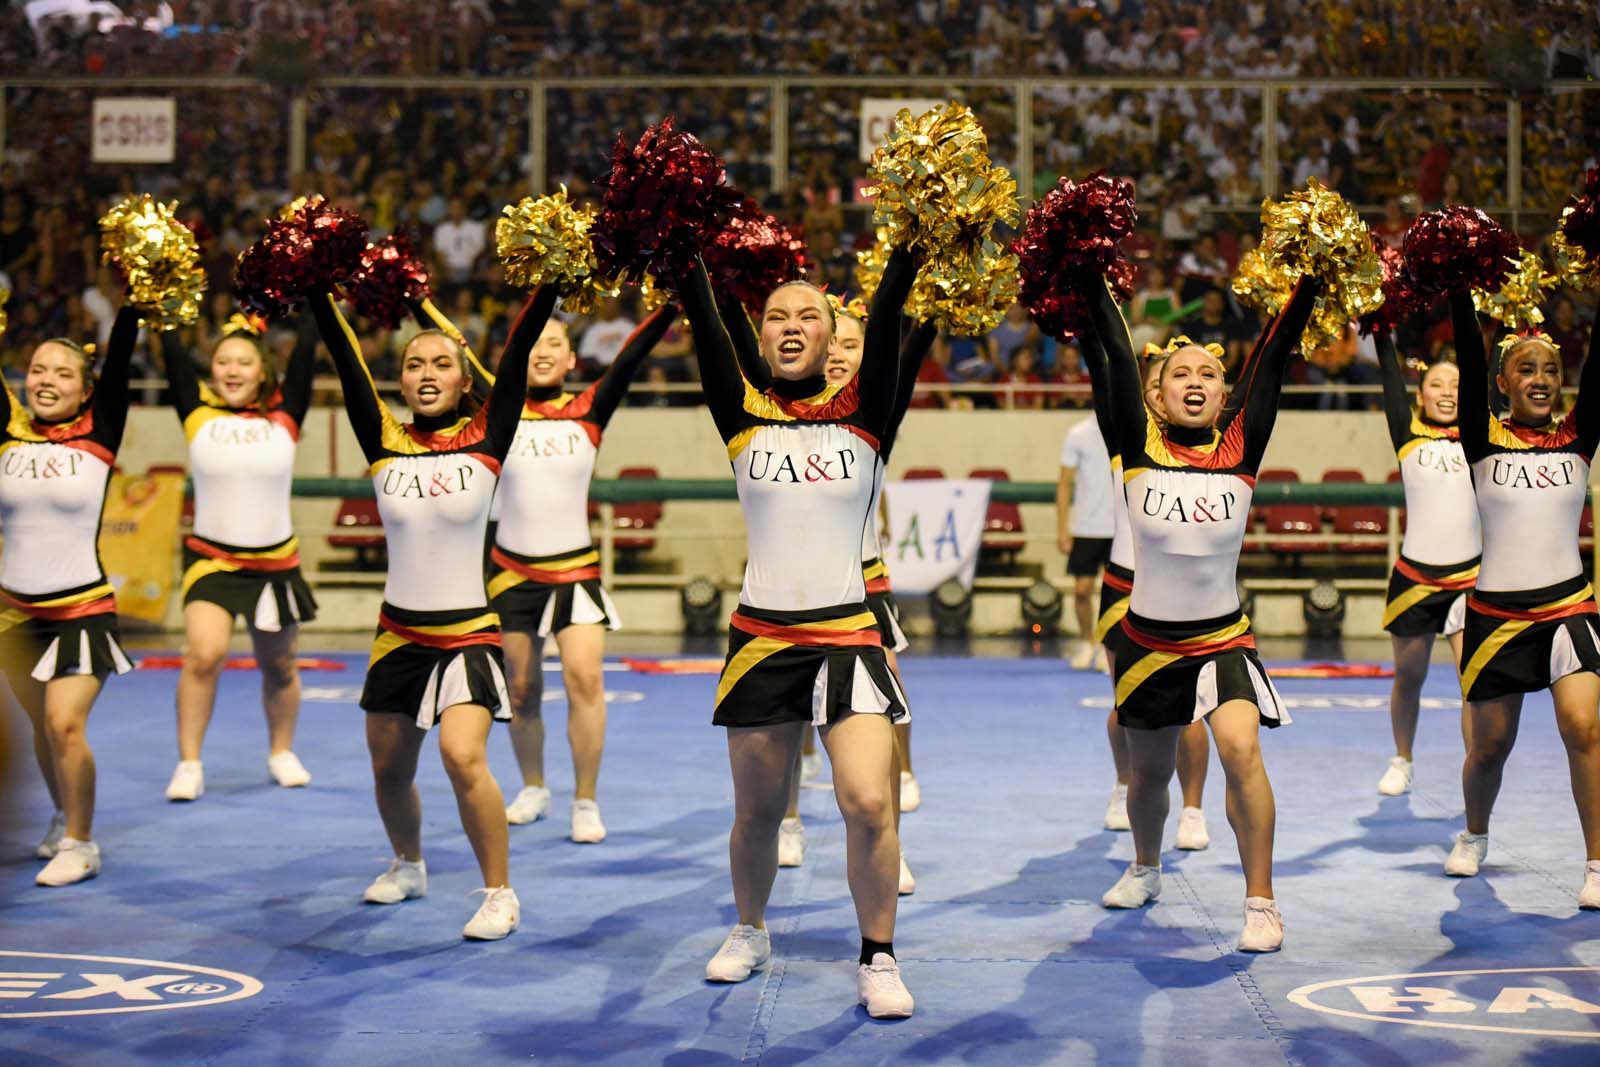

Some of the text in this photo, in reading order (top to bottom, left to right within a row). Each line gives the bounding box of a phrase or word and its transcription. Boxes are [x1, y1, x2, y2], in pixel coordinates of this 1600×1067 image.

[4, 451, 85, 479] UA&P
[383, 464, 474, 498] UA&P
[749, 449, 855, 483] UA&P
[1492, 459, 1575, 489] UA&P
[1143, 487, 1236, 523] UA&P
